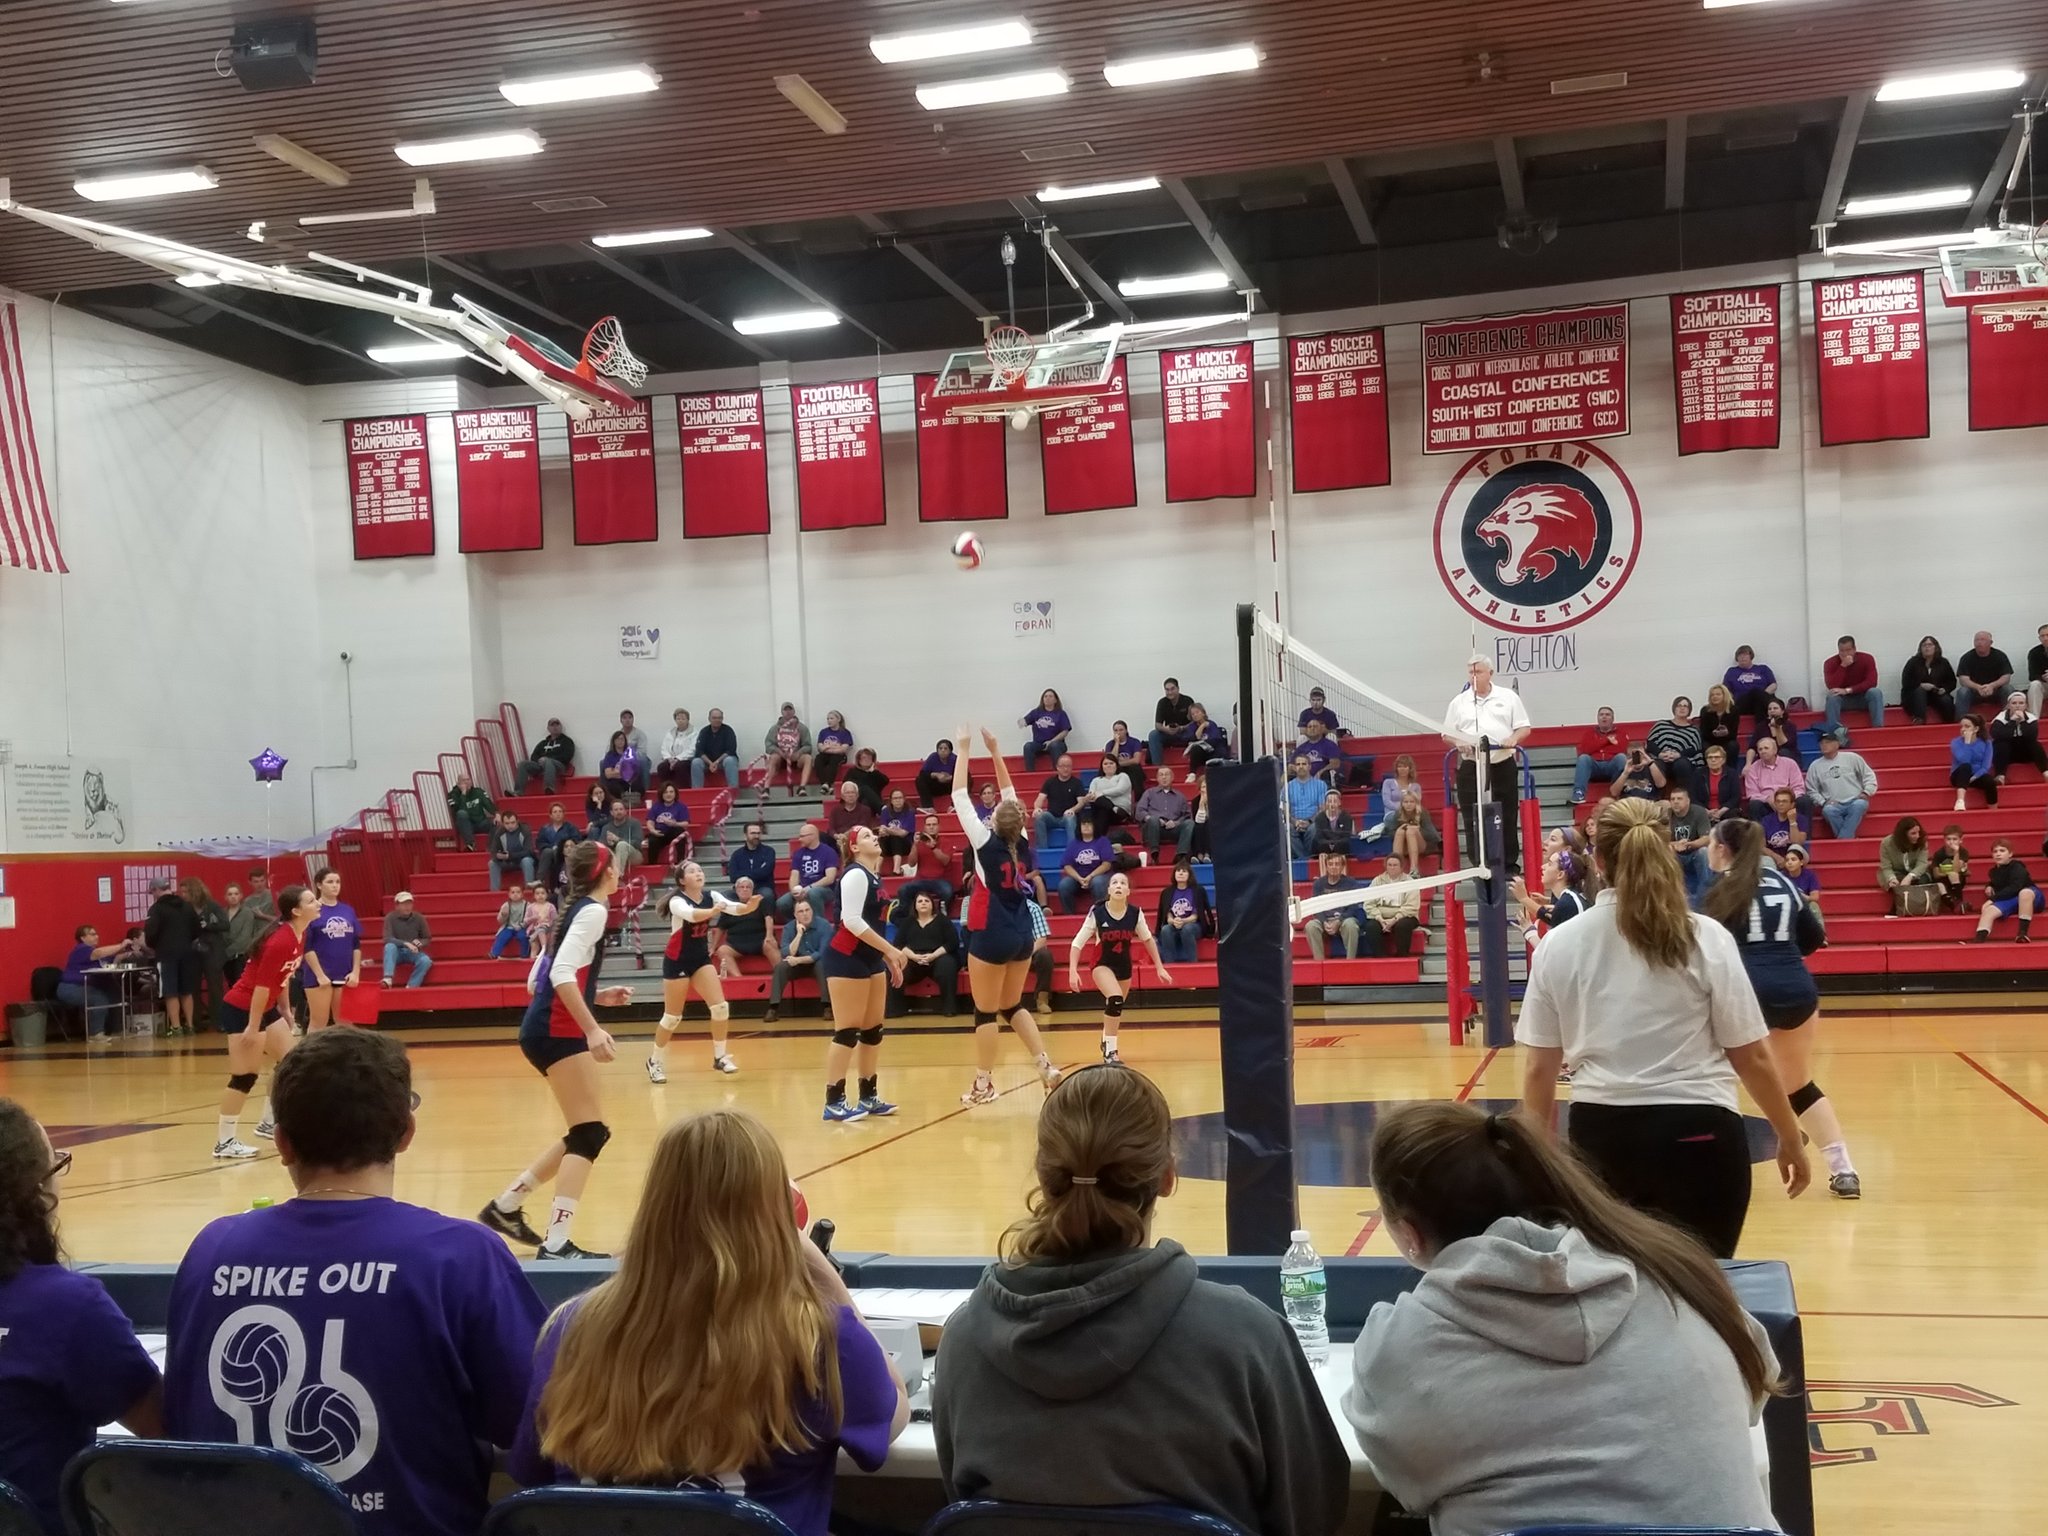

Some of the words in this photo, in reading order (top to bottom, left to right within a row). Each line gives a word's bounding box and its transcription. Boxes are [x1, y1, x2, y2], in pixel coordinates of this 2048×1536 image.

[1980, 270, 2010, 284] GIRLS
[1821, 284, 1854, 301] BOYS
[1859, 277, 1916, 296] SWIMMING
[1684, 292, 1766, 313] SOFTBALL
[1821, 295, 1918, 316] CHAMPIONSHIPS
[1679, 308, 1772, 329] CHAMPIONSHIPS
[1852, 317, 1888, 327] CCIAC
[1427, 325, 1530, 360] CONFERENCE
[1535, 314, 1625, 347] CHAMPIONS
[1709, 330, 1743, 340] CCIAC
[1823, 330, 1843, 340] 1977
[1297, 341, 1325, 356] BOYS
[1331, 335, 1373, 353] SOCCER
[1175, 354, 1192, 369] ICE
[1196, 349, 1238, 367] HOCKEY
[1295, 349, 1378, 371] CHAMPIONSHIPS
[1431, 366, 1451, 381] CROSS
[1456, 364, 1480, 379] COUNTY
[1485, 356, 1540, 376] INTERSCHOLASTIC
[1544, 352, 1574, 369] ATHLETIC
[1579, 347, 1619, 364] CONFERENCE
[1691, 358, 1720, 368] 2000
[1732, 355, 1764, 364] 2002
[1167, 364, 1247, 385] CHAMPIONSHIPS
[1322, 372, 1352, 382] CCIAC
[800, 384, 868, 403] FOOTBALL
[1441, 381, 1506, 401] COASTAL
[1512, 368, 1610, 394] CONFERENCE
[681, 398, 711, 411] CROSS
[715, 393, 757, 409] COUNTRY
[798, 398, 873, 417] CHAMPIONSHIPS
[1432, 402, 1503, 423] SOUTH-WEST
[1508, 393, 1580, 415] CONFERENCE
[1587, 389, 1620, 407] (SWC)
[456, 414, 478, 428] BOYS
[481, 411, 532, 426] BASKETBALL
[573, 416, 646, 434] CHAMPIONSHIPS
[683, 408, 757, 425] CHAMPIONSHIPS
[1075, 416, 1095, 424] SWC
[354, 420, 418, 436] BASEBALL
[460, 425, 532, 441] CHAMPIONSHIPS
[708, 428, 735, 436] CCIAC
[1430, 427, 1470, 444] SOUTHERN
[1475, 421, 1527, 439] CONNECTICUT
[1532, 414, 1583, 433] CONFERENCE
[1593, 410, 1619, 427] (SCC)
[352, 433, 422, 450] CHAMPIONSHIPS
[483, 444, 510, 452] CCIAC
[598, 435, 625, 444] CCIAC
[375, 452, 401, 460] CCIAC
[1476, 443, 1591, 478] FORAN
[1451, 555, 1624, 623] ATHLETICS
[1013, 602, 1031, 613] GO
[1015, 619, 1051, 630] FORAN
[1747, 894, 1791, 942] 17
[1112, 942, 1123, 953] 4
[212, 1265, 309, 1297] SPIKE
[318, 1262, 397, 1294] OUT
